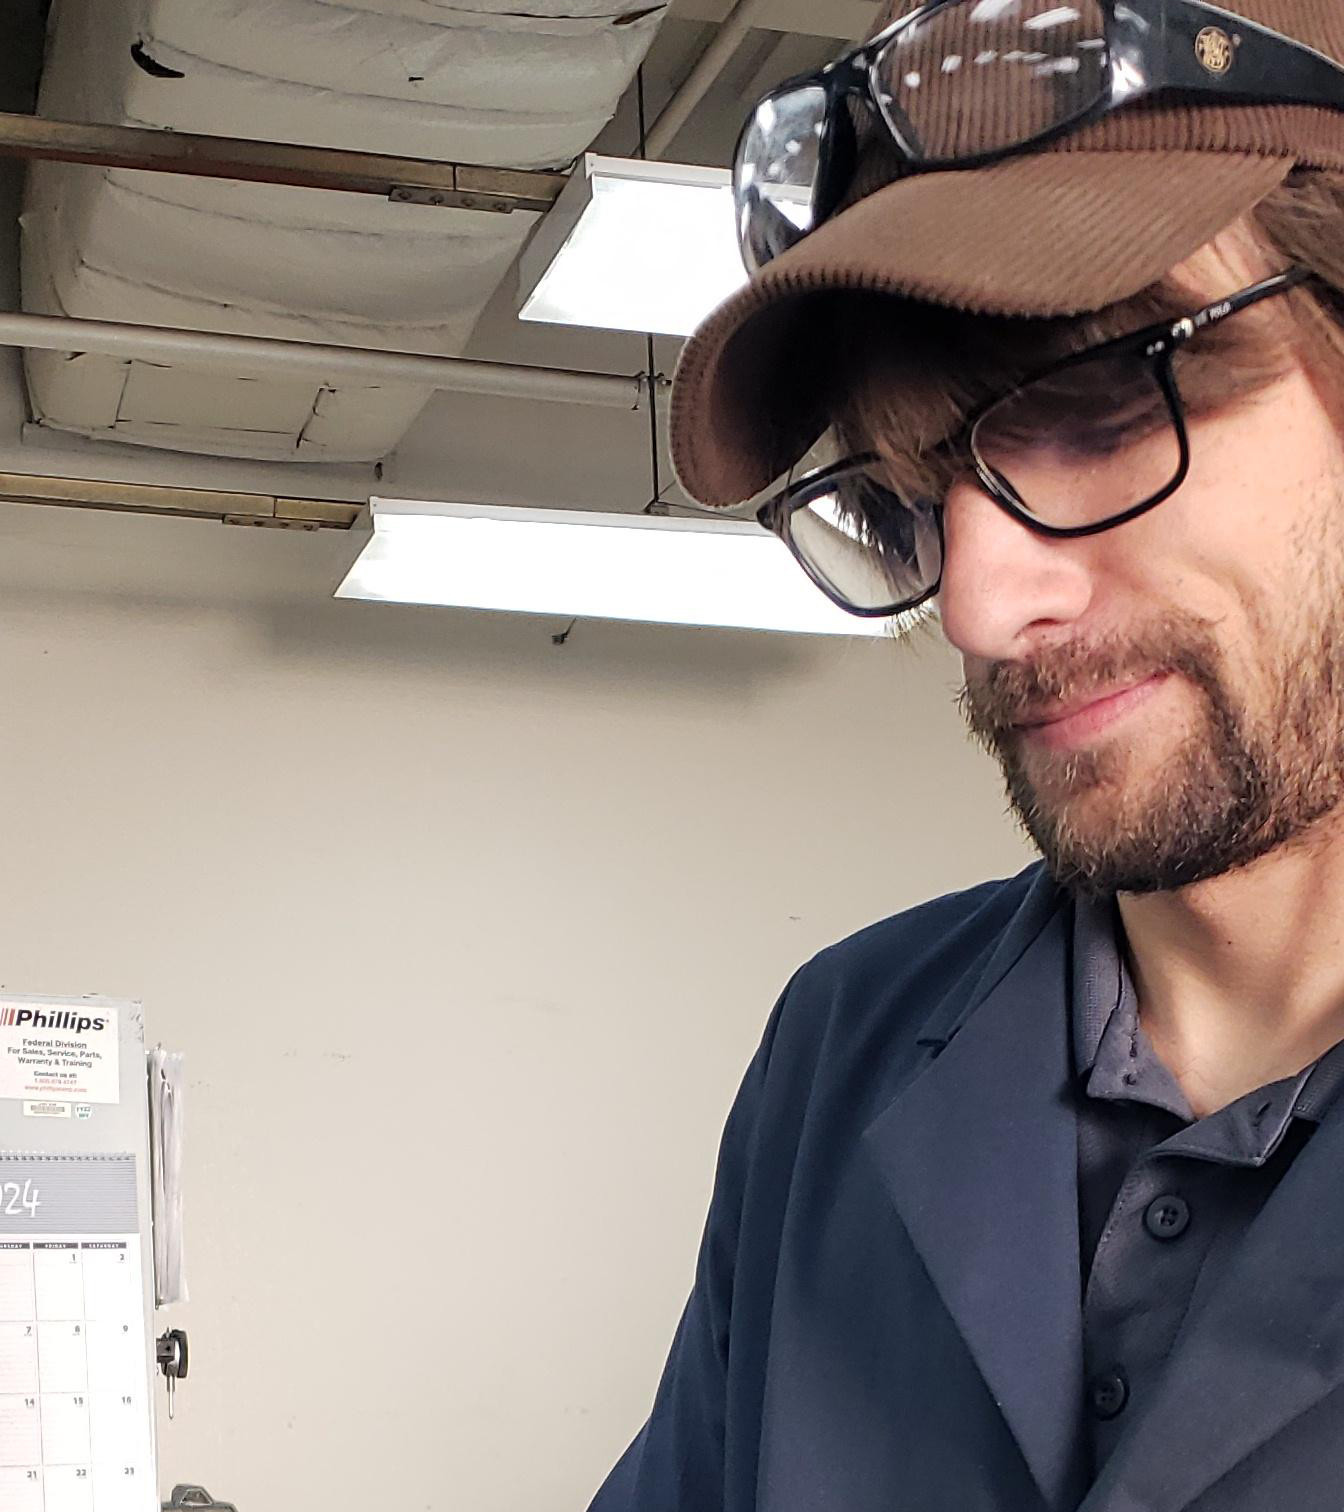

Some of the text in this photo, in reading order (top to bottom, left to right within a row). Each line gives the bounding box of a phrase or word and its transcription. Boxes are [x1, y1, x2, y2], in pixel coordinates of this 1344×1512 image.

[15, 1009, 105, 1034] Phillips
[22, 1039, 87, 1049] Federal Division
[8, 1047, 20, 1055] For
[18, 1057, 52, 1067] Warranty
[62, 1059, 93, 1068] Training
